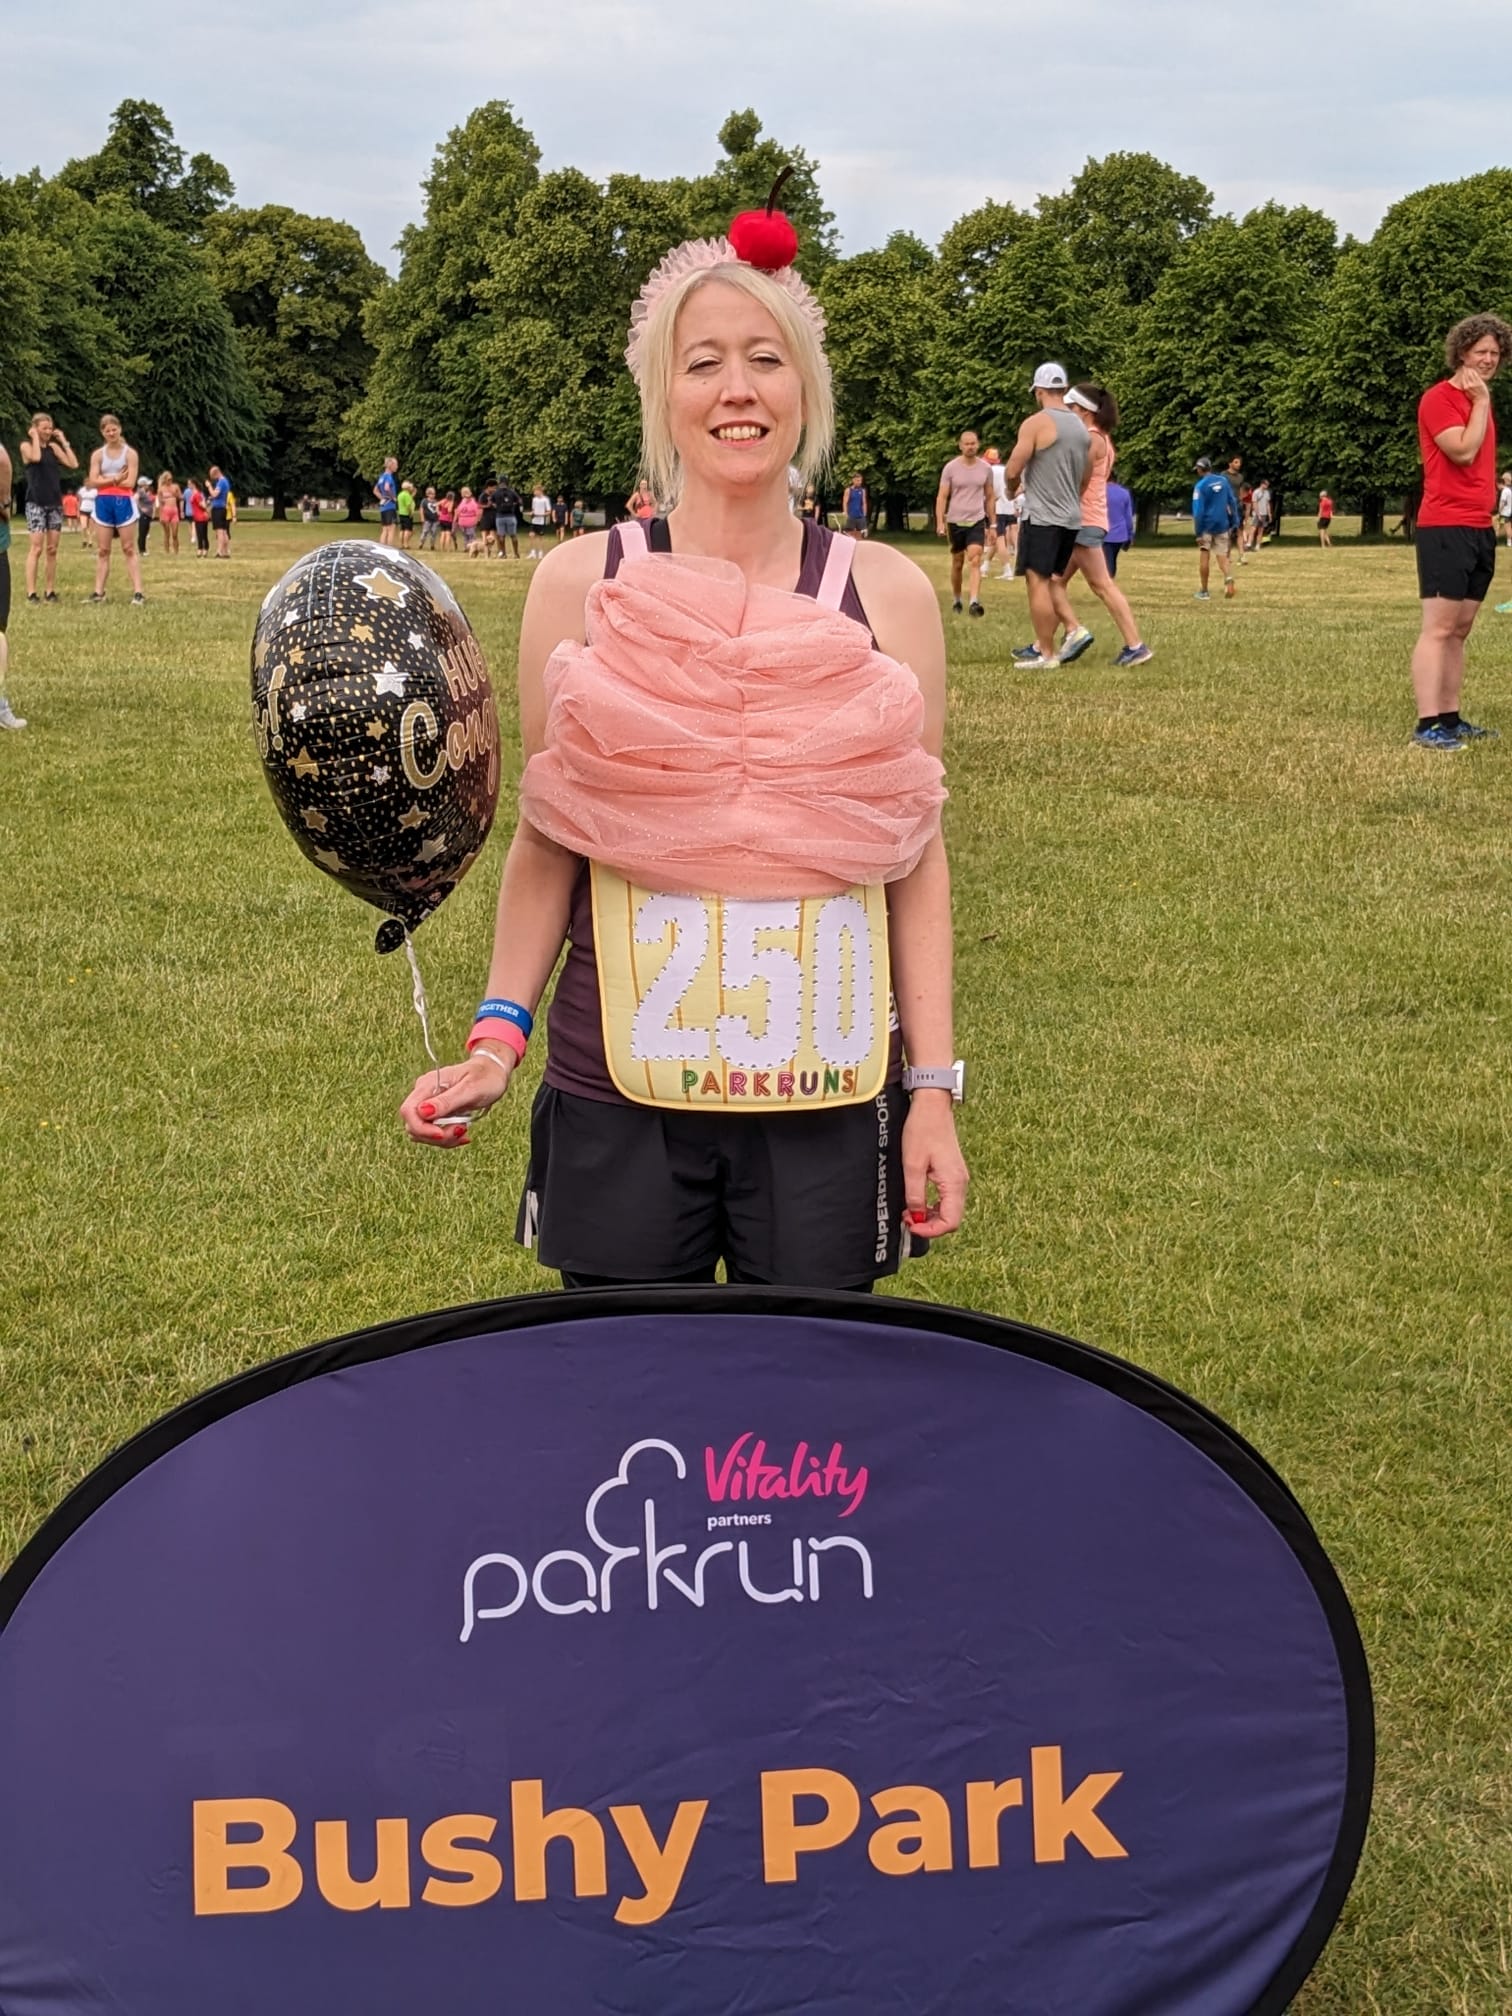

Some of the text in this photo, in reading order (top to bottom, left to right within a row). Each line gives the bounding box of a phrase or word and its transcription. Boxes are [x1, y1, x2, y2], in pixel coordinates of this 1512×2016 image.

[630, 893, 873, 1069] 250
[681, 1069, 854, 1097] PARKRUNS
[875, 1086, 889, 1263] SUPERDRY SPOR
[459, 1438, 874, 1643] parkrun
[705, 1431, 869, 1518] Vitality
[707, 1511, 773, 1531] partners
[192, 1745, 1130, 1926] Bushy Park
